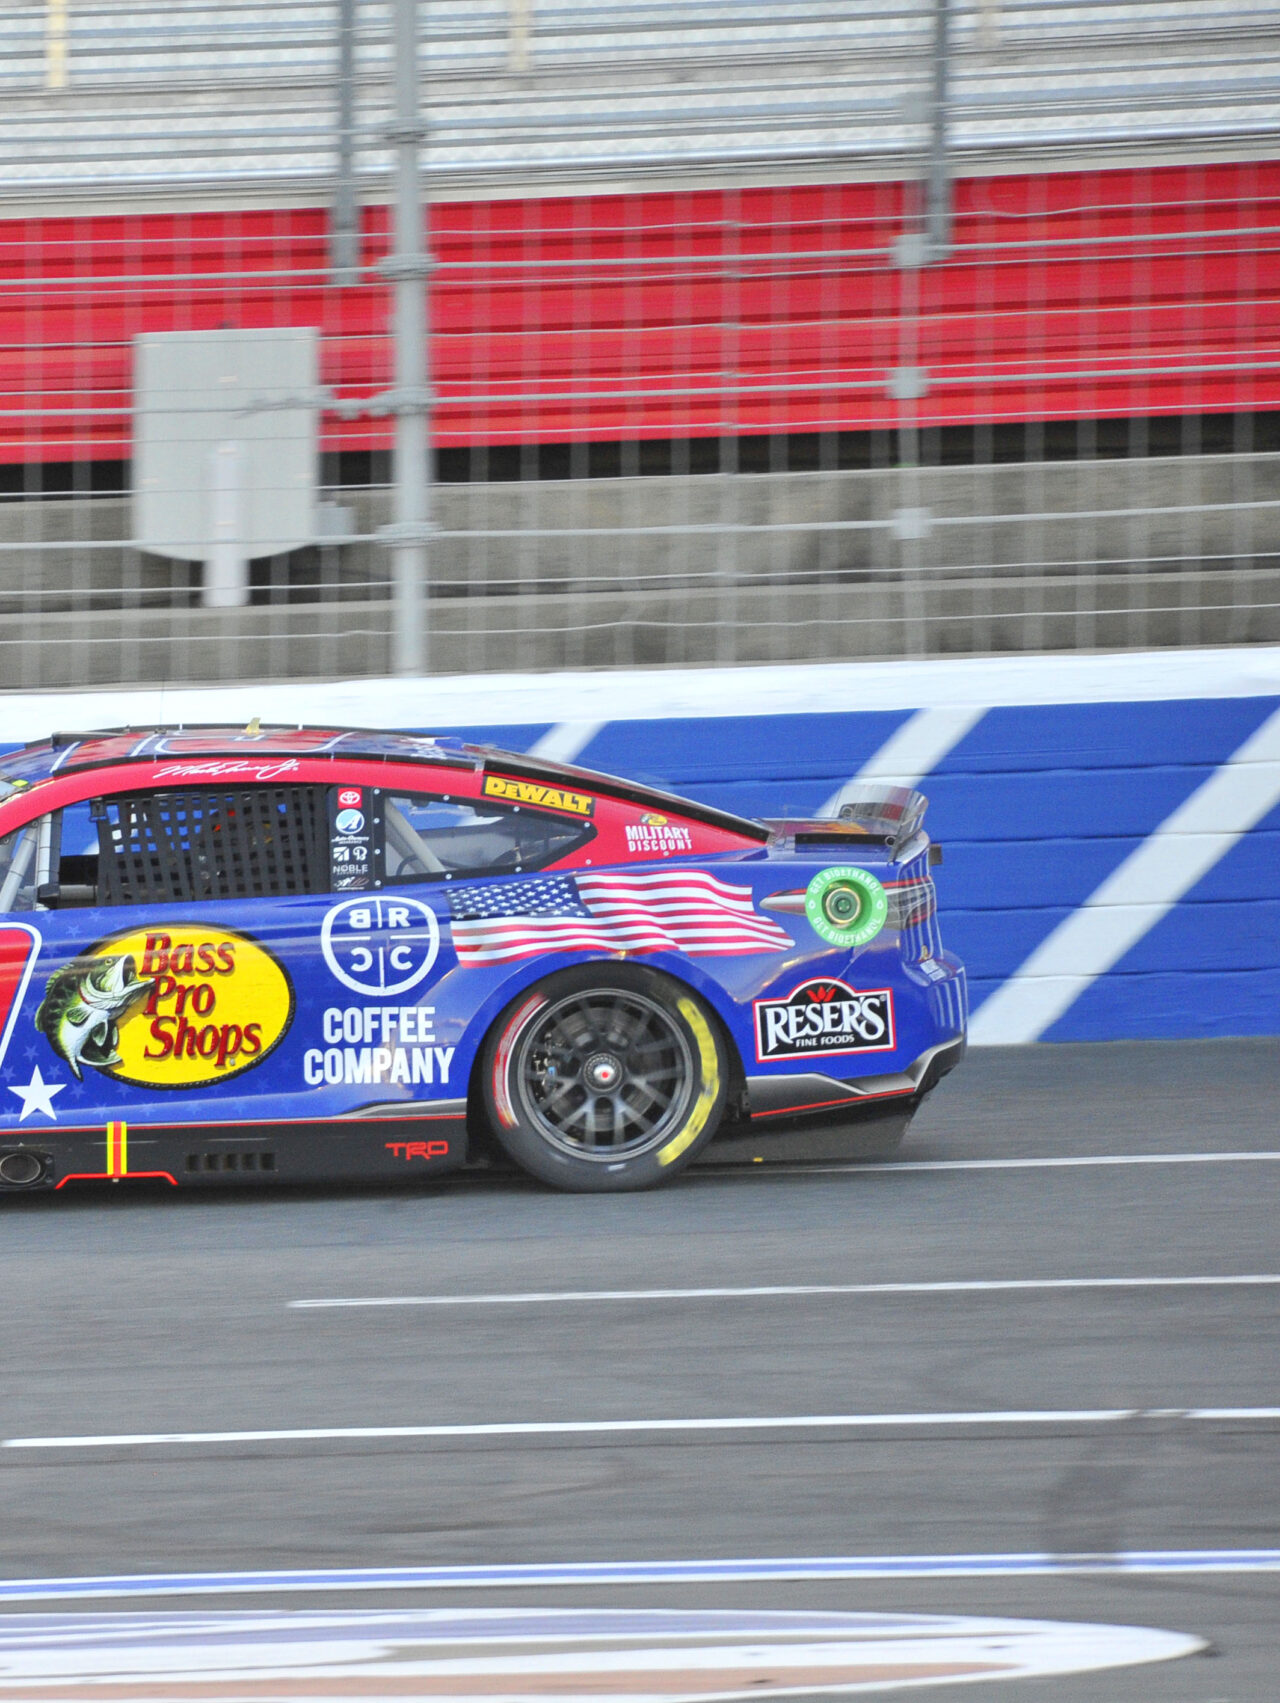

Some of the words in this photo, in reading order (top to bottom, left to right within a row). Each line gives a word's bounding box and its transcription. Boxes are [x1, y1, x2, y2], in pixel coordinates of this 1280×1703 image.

[625, 825, 689, 841] MILITARY
[628, 839, 692, 852] DISCOUNT
[333, 864, 368, 874] NOBLE
[811, 877, 825, 894] GET
[823, 868, 880, 894] BIOETHANOL
[813, 917, 829, 934] GET
[828, 918, 881, 944] BIOETHANOL
[139, 933, 236, 976] Bass
[142, 975, 216, 1016] Pro
[323, 1006, 436, 1044] COFFEE
[765, 996, 885, 1053] RESER'S
[144, 1015, 262, 1067] Shops
[795, 1037, 818, 1048] FINE
[821, 1034, 855, 1045] FOODS
[303, 1047, 456, 1085] COMPANY
[385, 1140, 449, 1161] TRD
